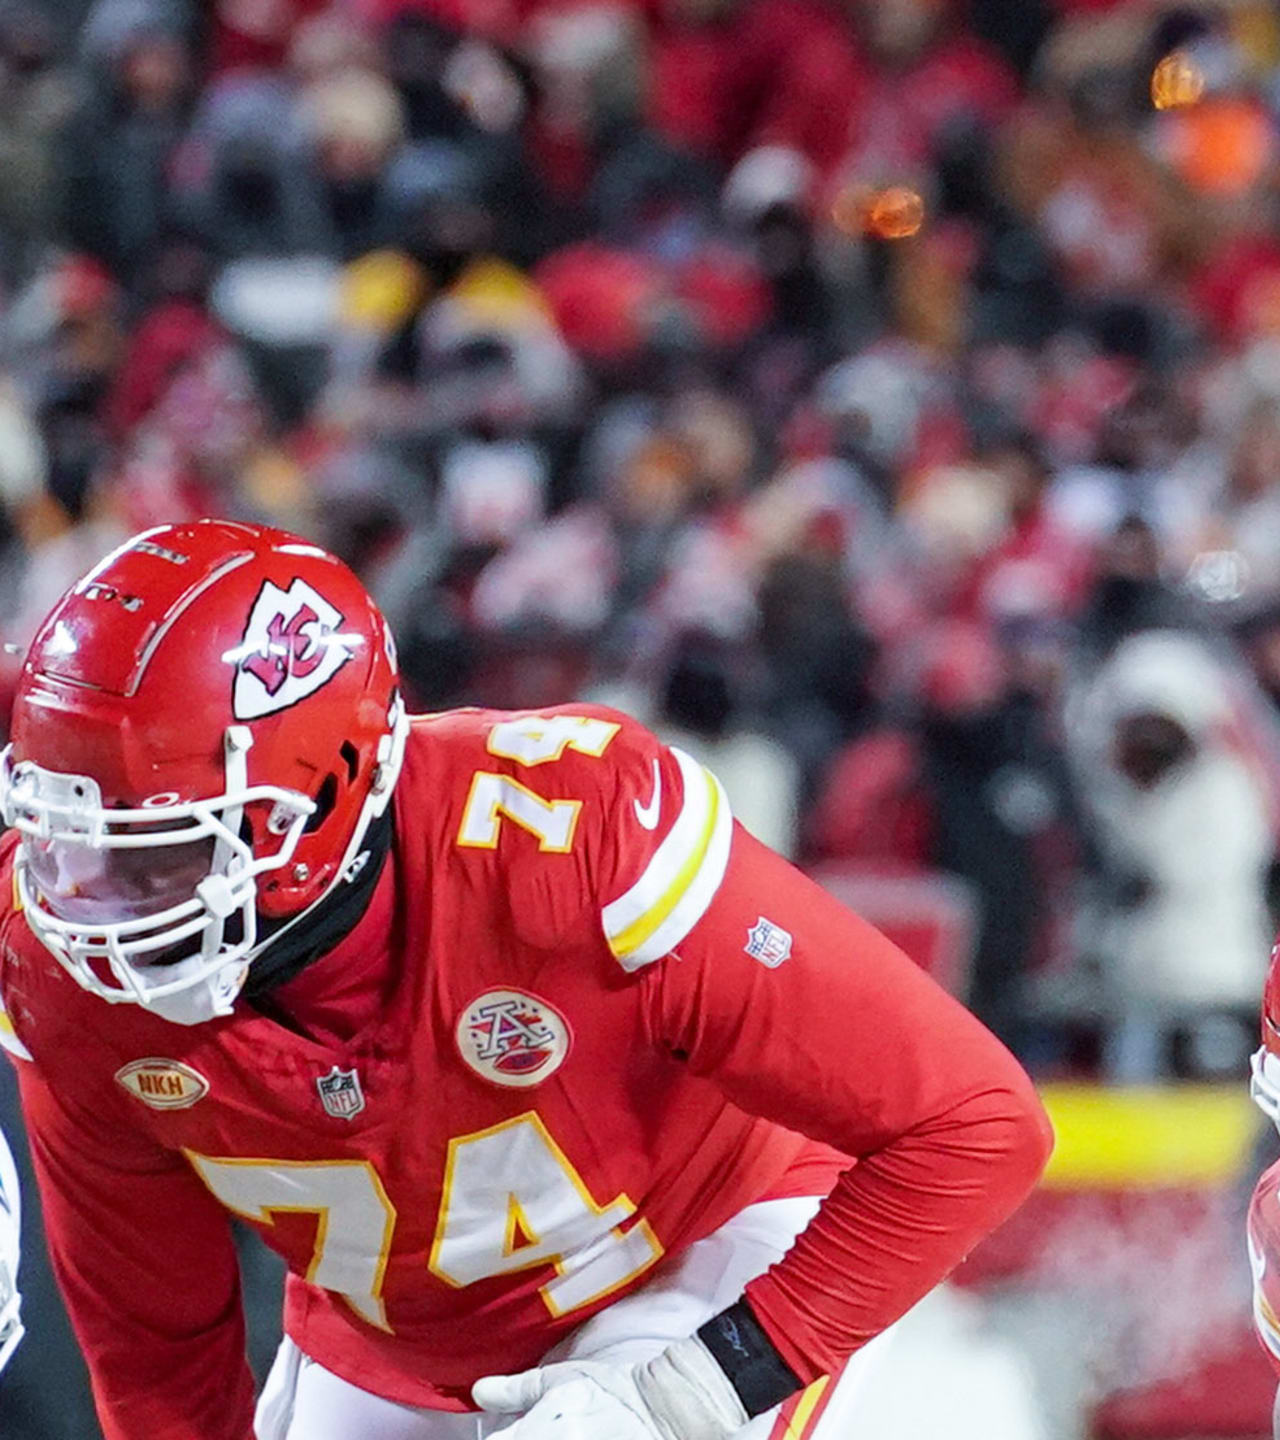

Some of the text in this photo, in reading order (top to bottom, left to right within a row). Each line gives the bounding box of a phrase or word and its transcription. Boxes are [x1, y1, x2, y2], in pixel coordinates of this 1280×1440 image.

[457, 714, 621, 854] 74
[137, 1073, 184, 1097] NKH
[327, 1090, 360, 1114] NFL
[183, 1111, 664, 1335] 74
